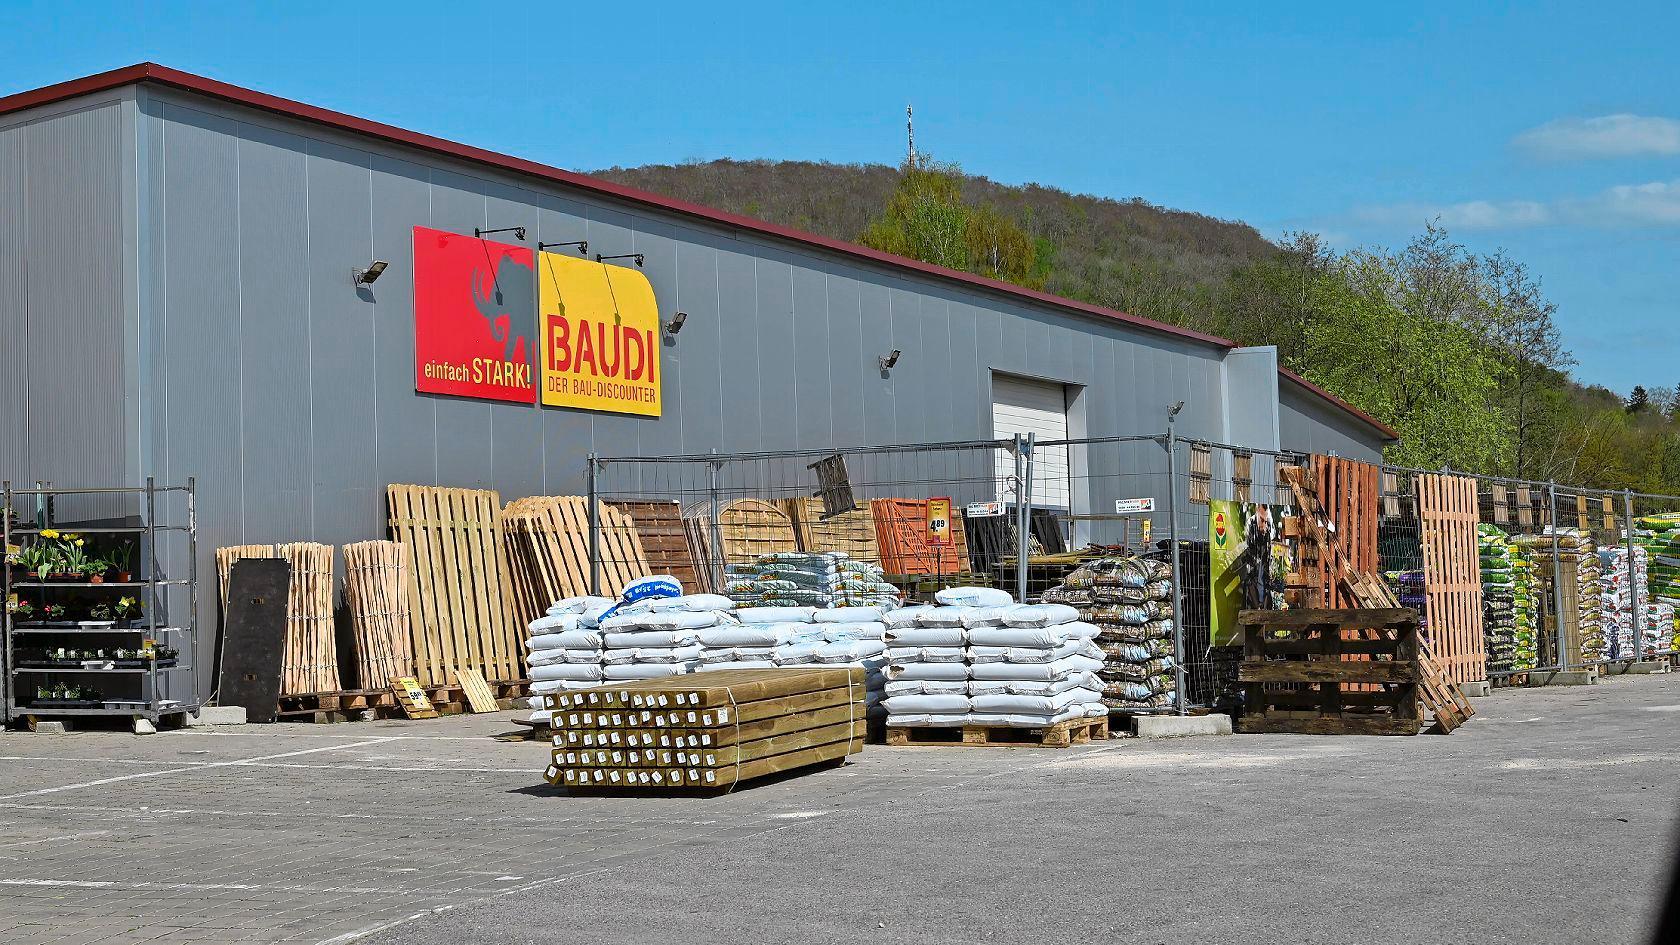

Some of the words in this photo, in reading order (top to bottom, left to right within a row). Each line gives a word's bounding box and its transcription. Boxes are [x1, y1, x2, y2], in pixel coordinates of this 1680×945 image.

[547, 314, 655, 383] BAUDI
[424, 360, 469, 382] einfach
[472, 357, 531, 389] STARK!
[548, 375, 569, 393] DER
[573, 378, 656, 404] BAU-DISCOUNTER
